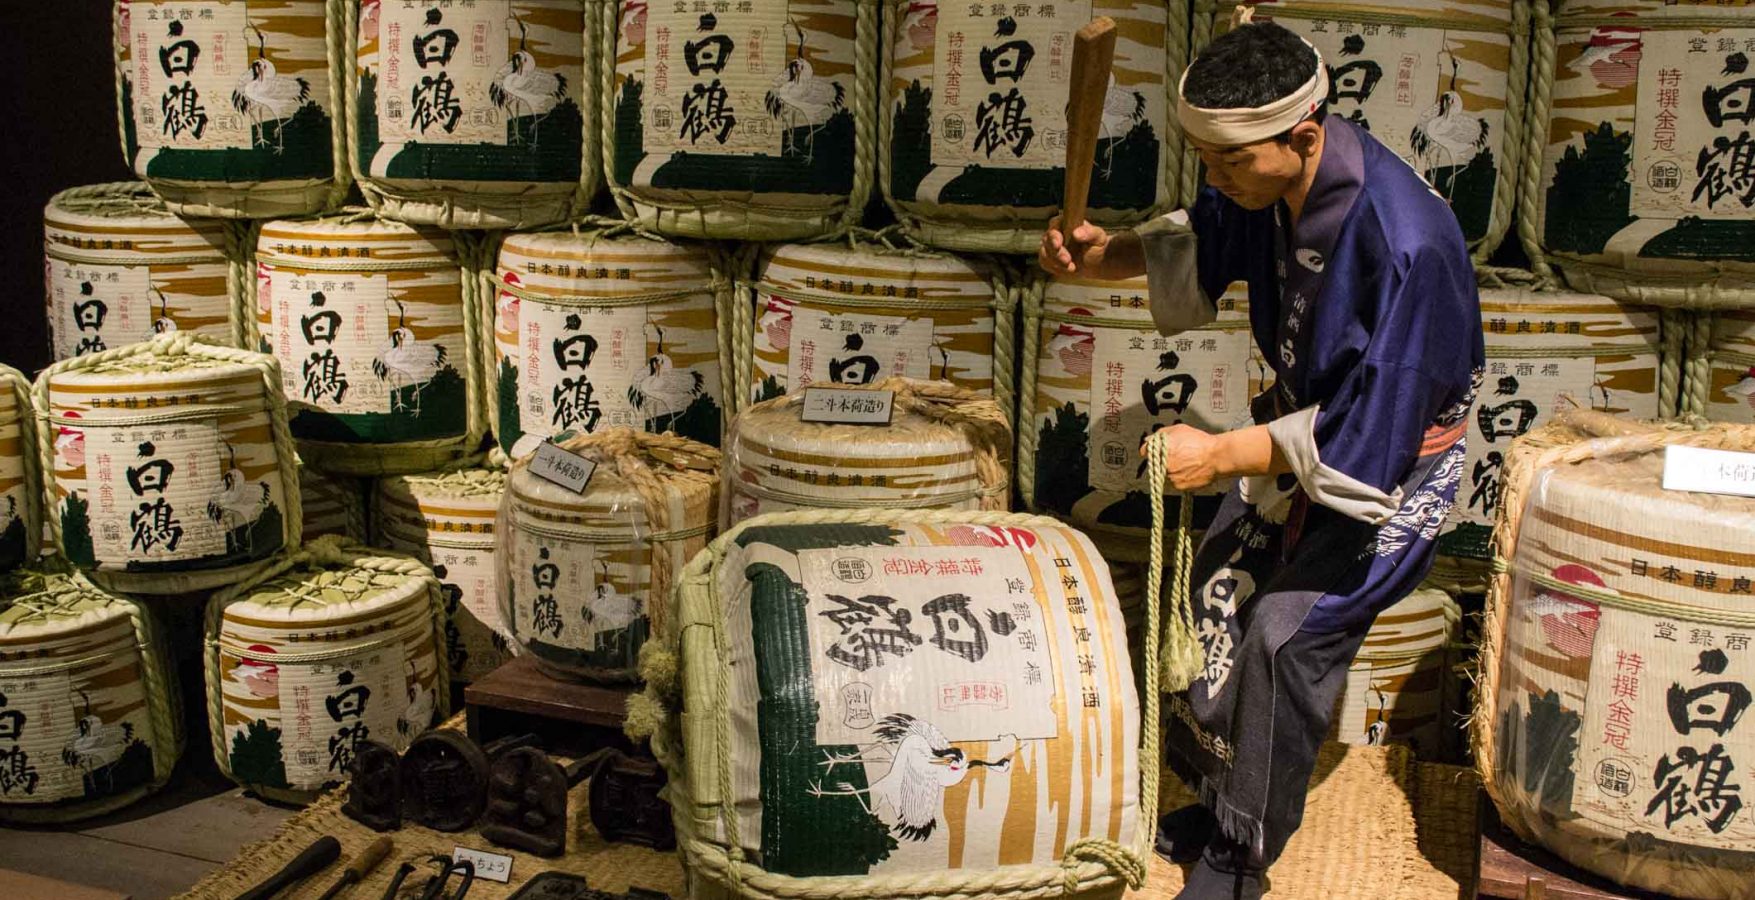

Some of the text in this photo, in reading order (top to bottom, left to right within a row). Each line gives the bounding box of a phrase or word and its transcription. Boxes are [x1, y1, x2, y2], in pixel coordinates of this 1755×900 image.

[968, 3, 1057, 19] 登録商標
[158, 19, 208, 141] 白鶴
[411, 8, 464, 135] 白鶴
[653, 26, 671, 97] 特撰金冠
[679, 13, 737, 145] 白鶴
[944, 31, 965, 106] 特撰金冠
[972, 16, 1036, 160] 白鶴
[1652, 67, 1683, 152] 特撰金冠
[1691, 52, 1755, 210] 白鶴
[277, 243, 370, 258] 日本醇良清酒
[527, 261, 631, 281] 日本醇良清酒
[805, 276, 919, 299] 日本醇良清酒
[301, 291, 349, 404] 白鶴
[819, 317, 902, 336] 登録商標
[1128, 336, 1218, 352] 登録商標
[552, 314, 602, 434] 白鶴
[810, 398, 884, 413] 二斗本荷造り
[1103, 360, 1125, 434] 特撰金冠
[127, 440, 184, 555] 白鶴
[769, 464, 887, 487] 日本醇良清酒
[532, 547, 564, 639] 白鶴
[883, 556, 984, 577] 特撰金冠
[1631, 558, 1752, 594] 日本醇良
[818, 593, 1018, 673] 白鶴
[1005, 576, 1043, 686] 登録商標
[1053, 556, 1101, 708] 日本醇良清酒
[1653, 621, 1752, 652] 登録商
[1602, 650, 1645, 751] 特撰金冠
[1644, 648, 1753, 834] 白鶴
